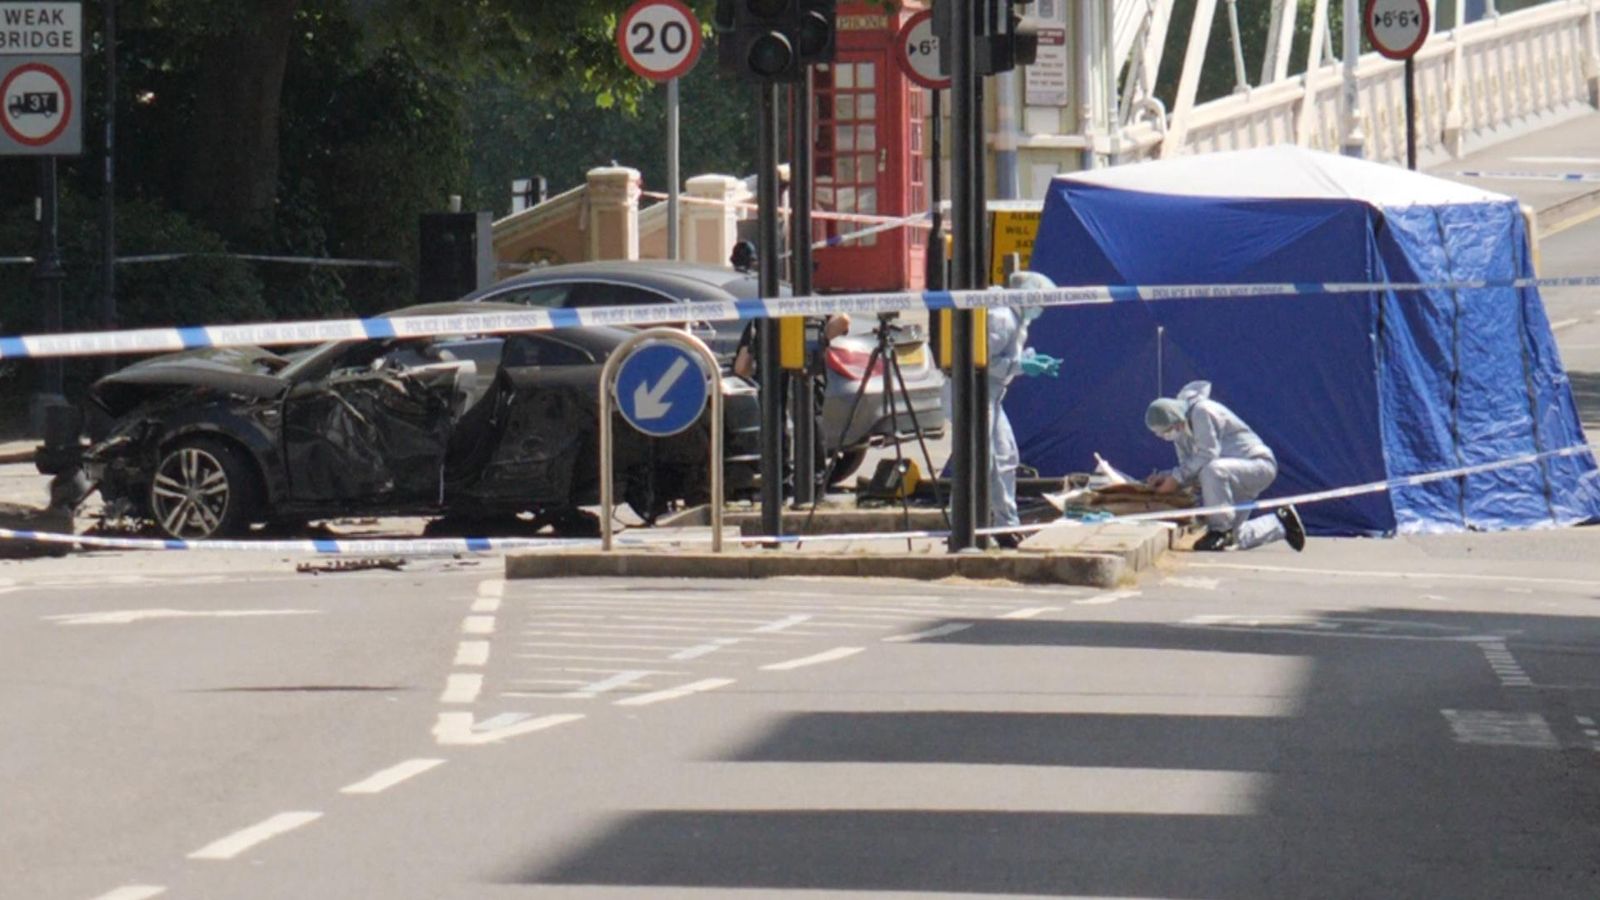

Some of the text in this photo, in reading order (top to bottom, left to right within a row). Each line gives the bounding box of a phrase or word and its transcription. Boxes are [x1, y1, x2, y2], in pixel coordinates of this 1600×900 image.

[4, 8, 65, 25] WEAK
[0, 30, 74, 48] BRIDGE
[631, 21, 687, 54] 20
[966, 290, 1098, 307] POLICE LINE DO NOT CROSS
[1152, 287, 1185, 298] POLICE
[591, 303, 724, 322] POLICE LINE DO NOT CROSS
[778, 296, 911, 313] POLICE LINE DO NOT CROSS
[405, 313, 537, 332] POLICE LINE DO NOT CROSS
